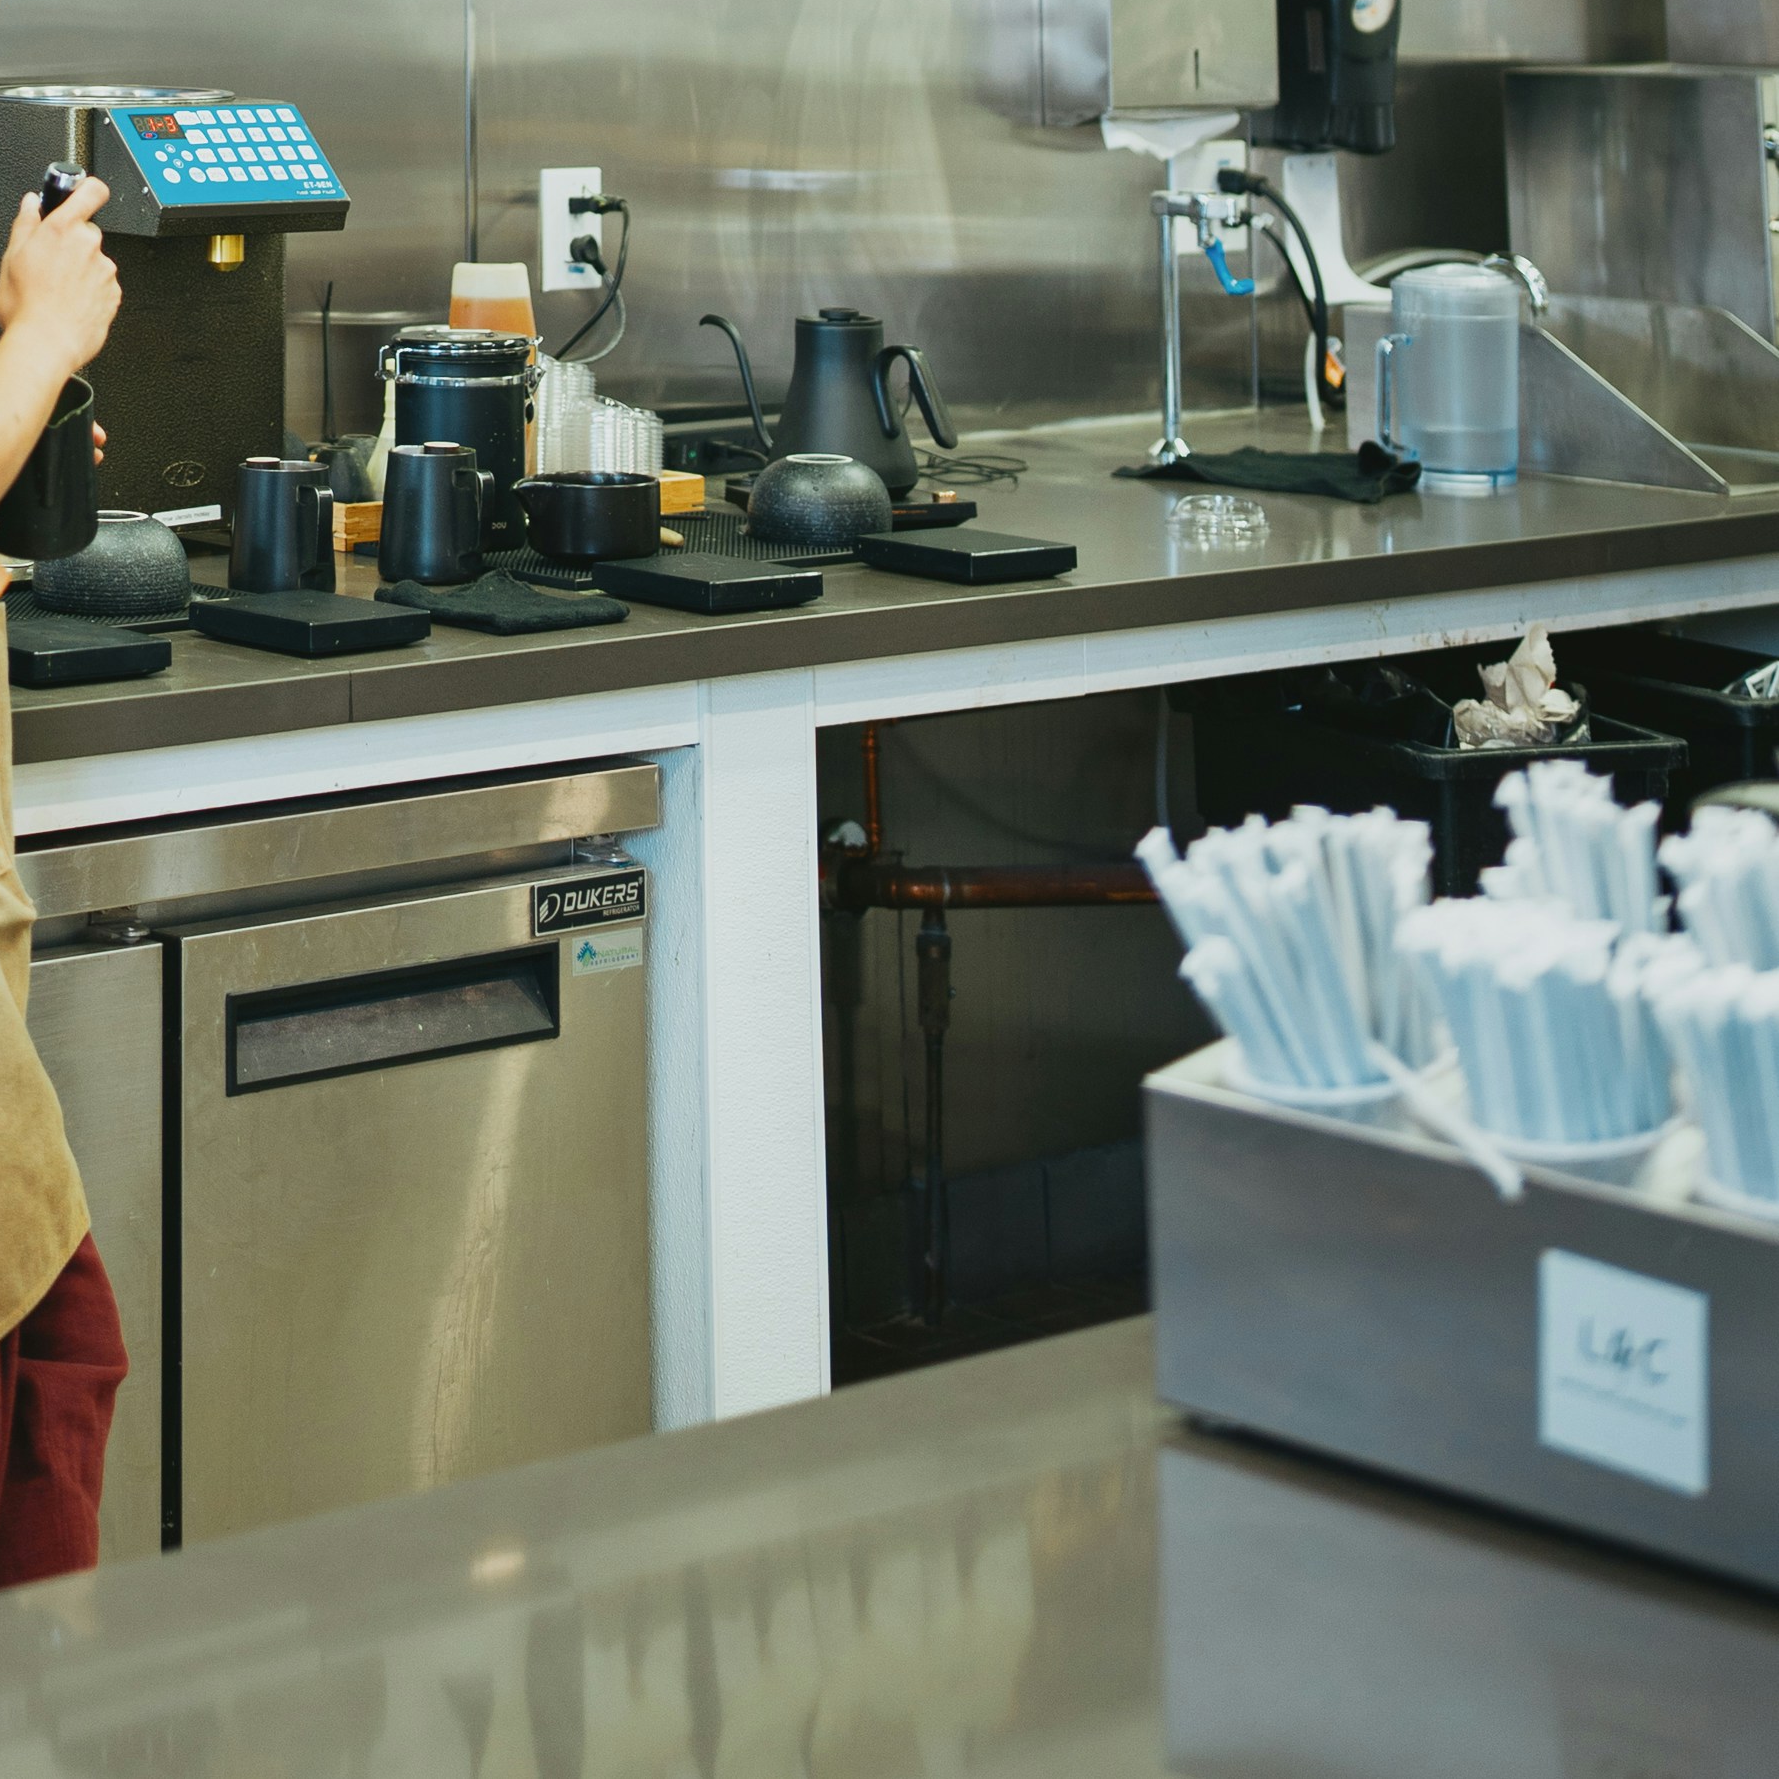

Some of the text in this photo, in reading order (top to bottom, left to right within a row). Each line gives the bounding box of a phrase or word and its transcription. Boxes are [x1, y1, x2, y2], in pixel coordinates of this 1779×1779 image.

[563, 881, 639, 912] DUKERS
[602, 903, 640, 917] REFRIGERATOR
[597, 945, 639, 958] NATURAL
